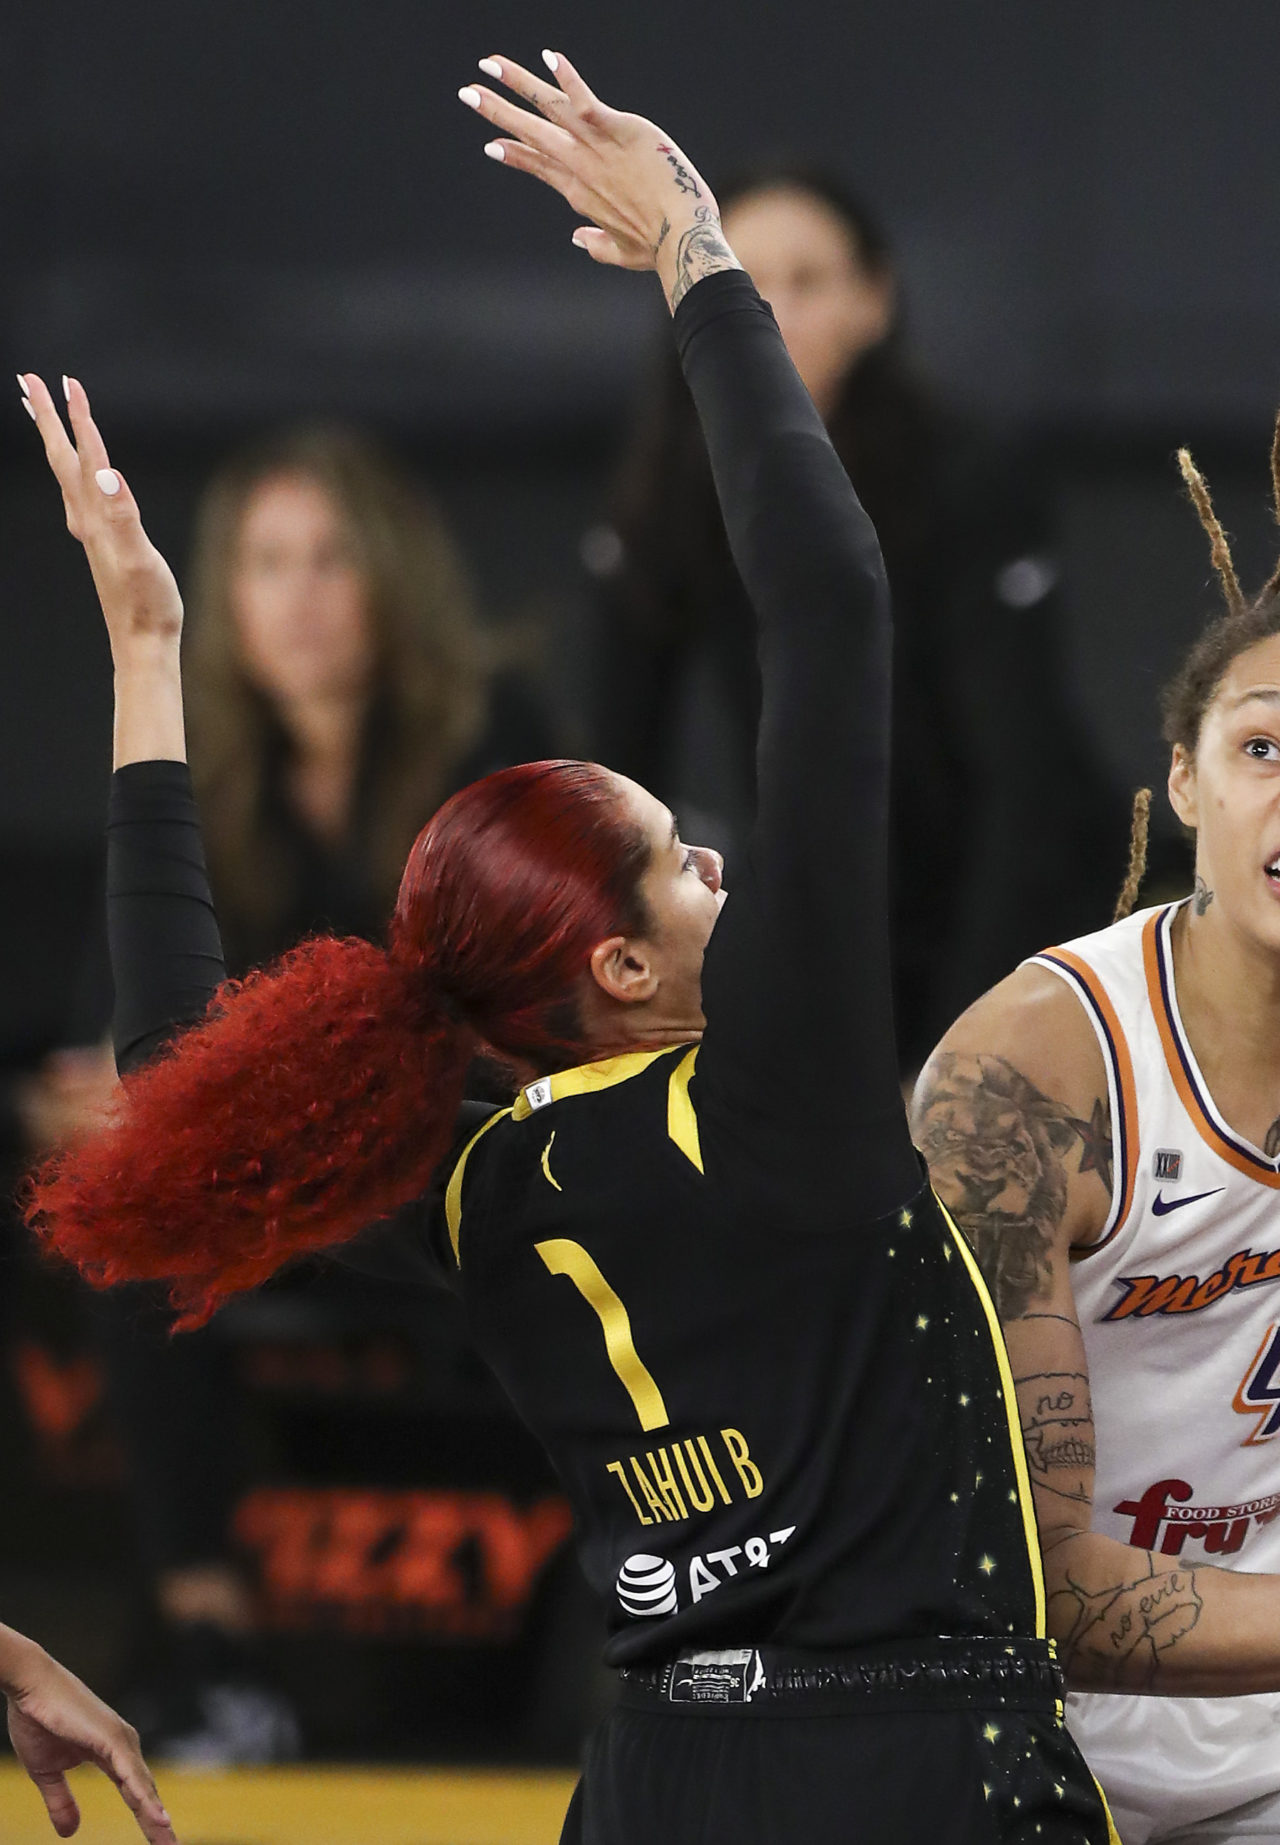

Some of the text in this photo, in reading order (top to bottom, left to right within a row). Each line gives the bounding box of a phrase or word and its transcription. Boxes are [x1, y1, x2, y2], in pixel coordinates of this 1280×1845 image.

[533, 1238, 670, 1432] 1
[606, 1428, 764, 1526] ZAHUI B
[1165, 1506, 1220, 1520] FOOD
